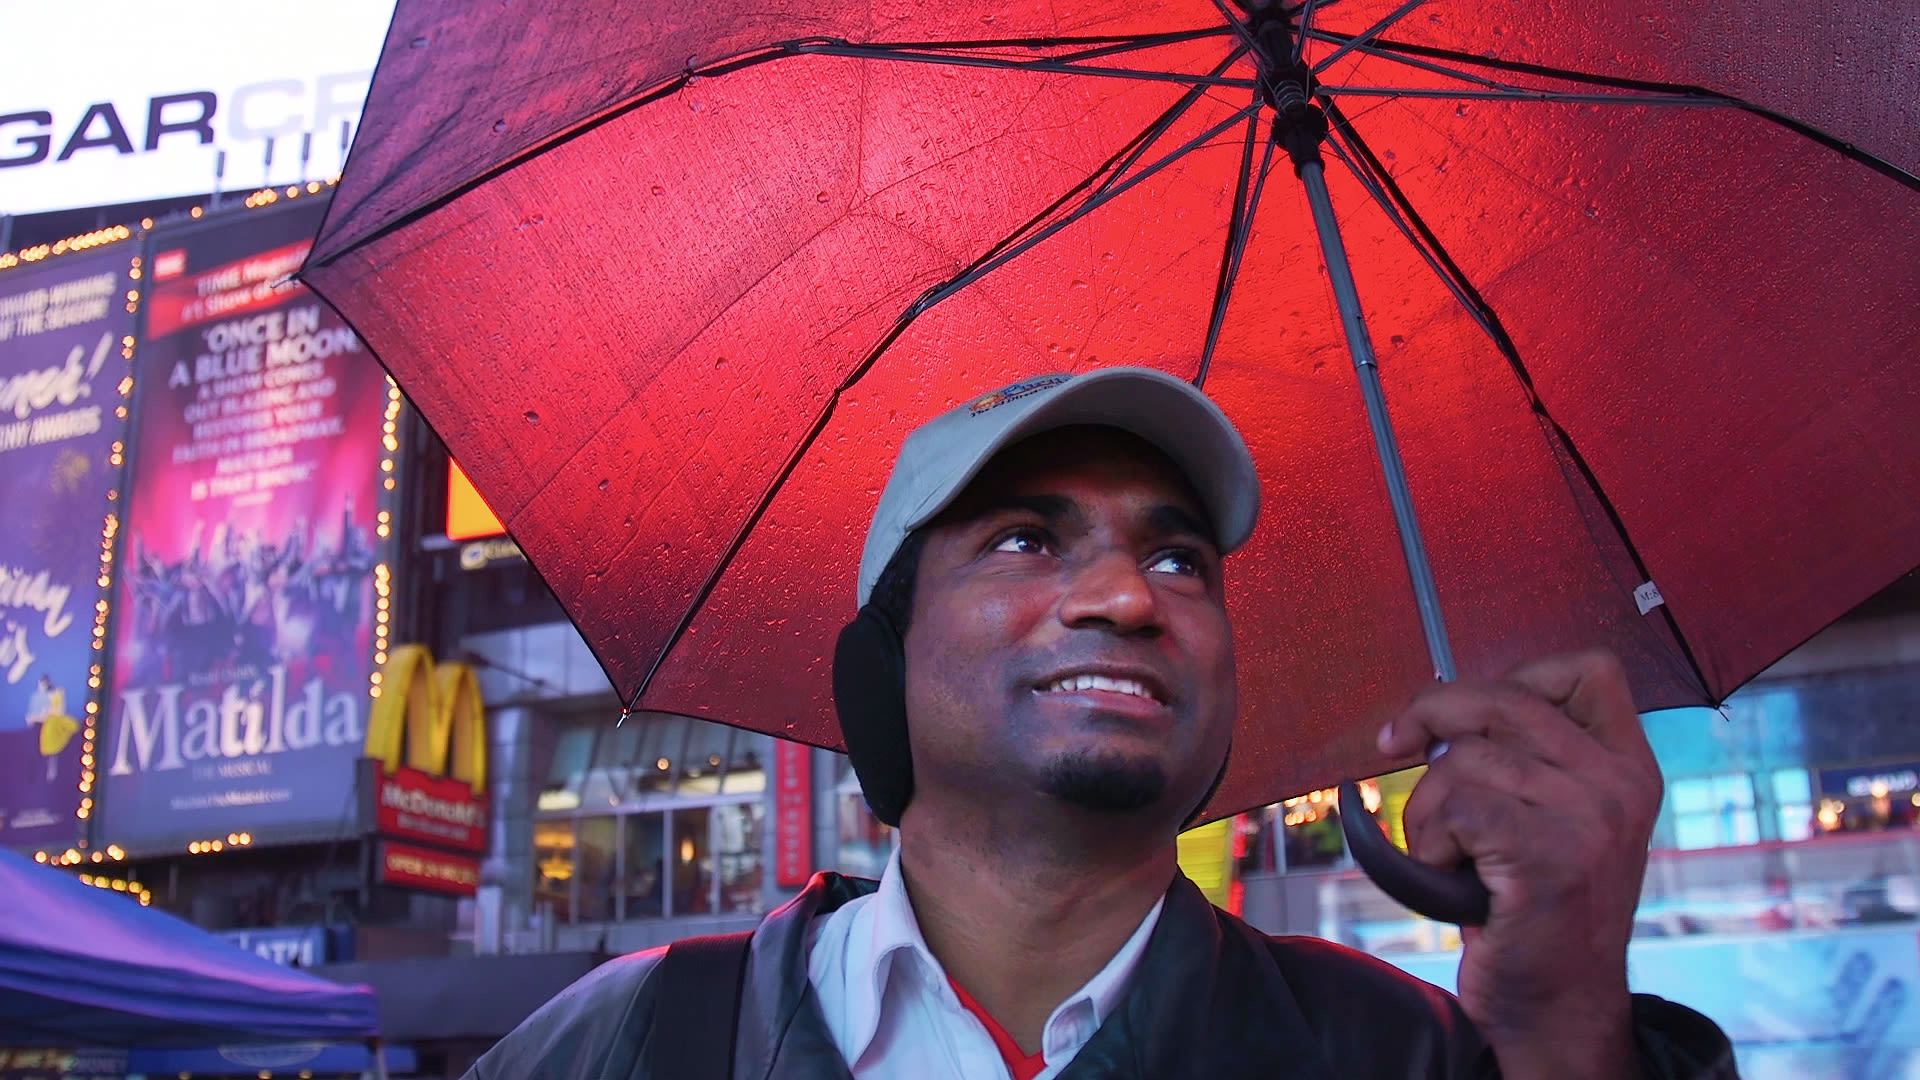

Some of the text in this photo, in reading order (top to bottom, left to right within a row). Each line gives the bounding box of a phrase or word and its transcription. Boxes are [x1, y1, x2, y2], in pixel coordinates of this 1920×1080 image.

[287, 304, 321, 338] IN
[168, 359, 191, 389] A
[195, 345, 265, 383] BLUE
[109, 664, 363, 777] Matilda
[381, 783, 487, 830] McDonald's
